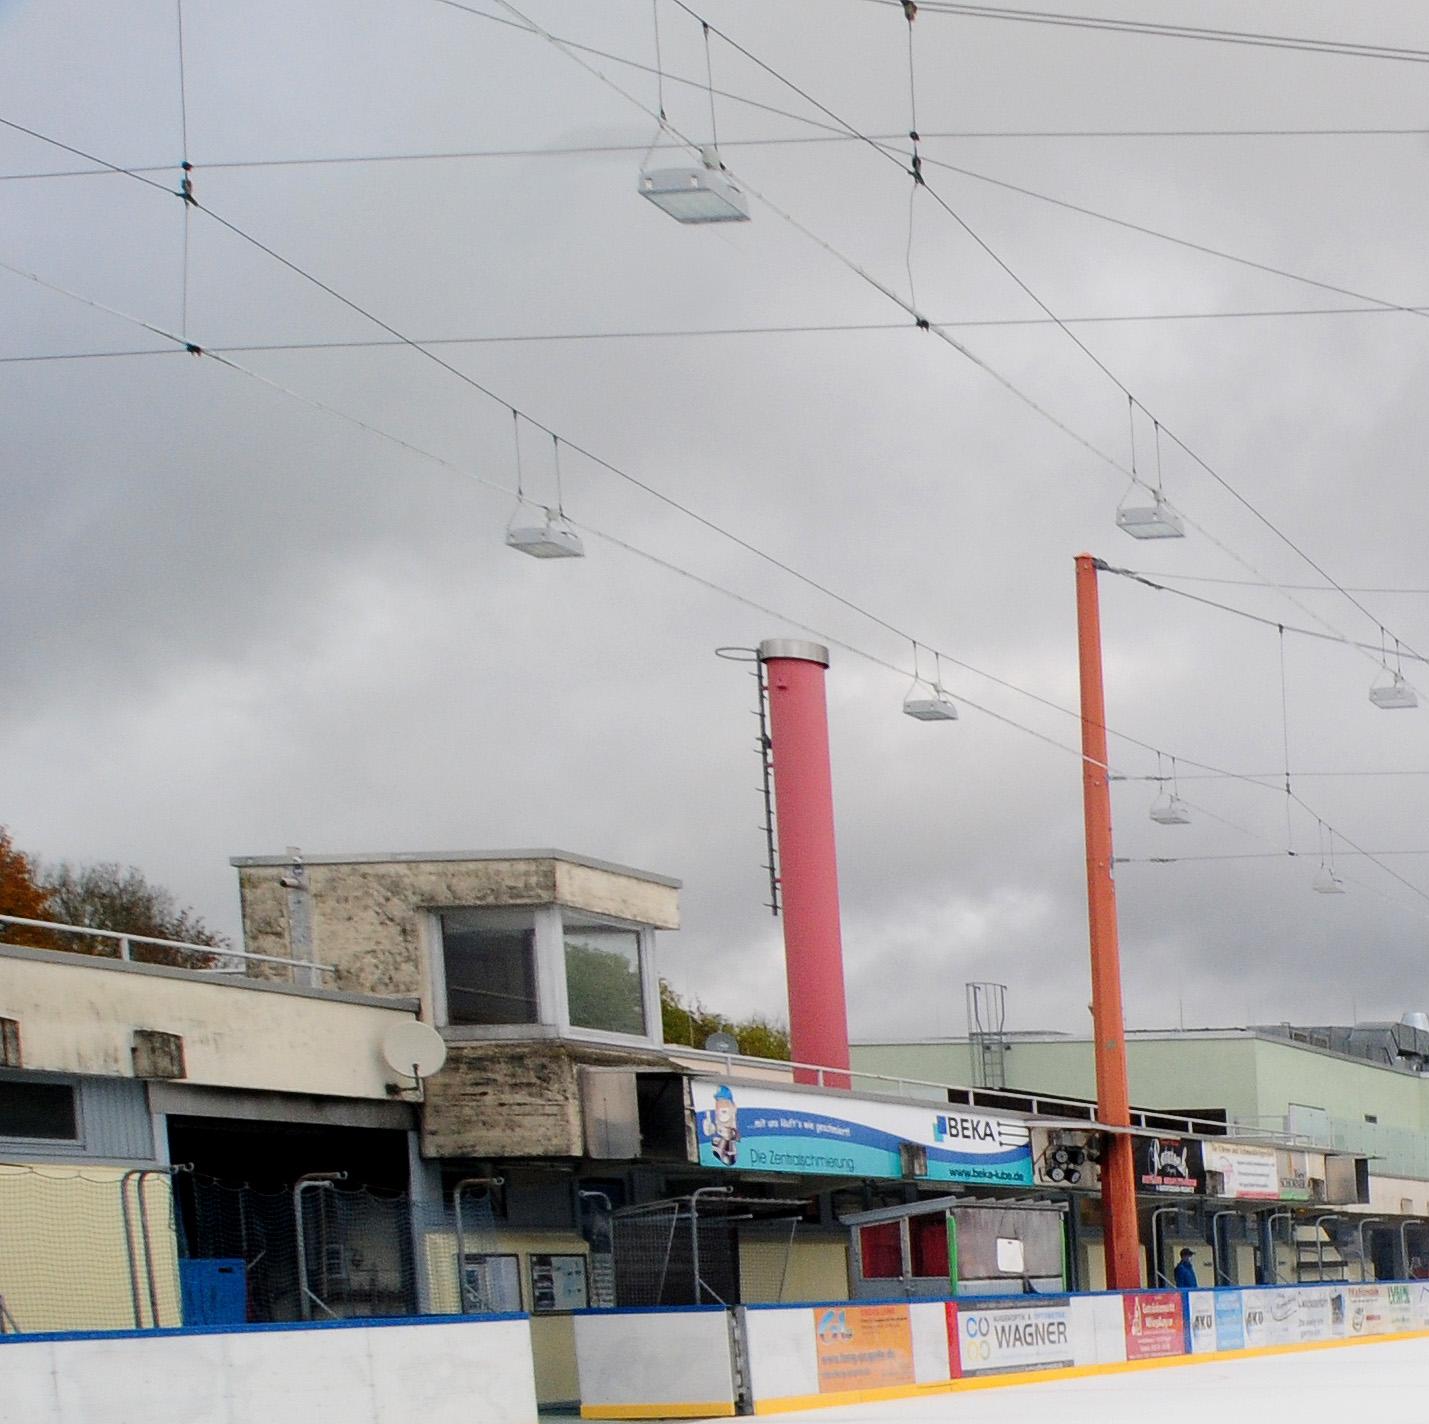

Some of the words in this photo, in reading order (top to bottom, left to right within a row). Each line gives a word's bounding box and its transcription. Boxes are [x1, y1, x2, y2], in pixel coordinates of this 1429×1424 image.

[948, 1117, 995, 1141] BEKA
[750, 1148, 767, 1164] Die
[769, 1150, 855, 1173] Zentralschmierung
[993, 1321, 1068, 1349] WAGNER
